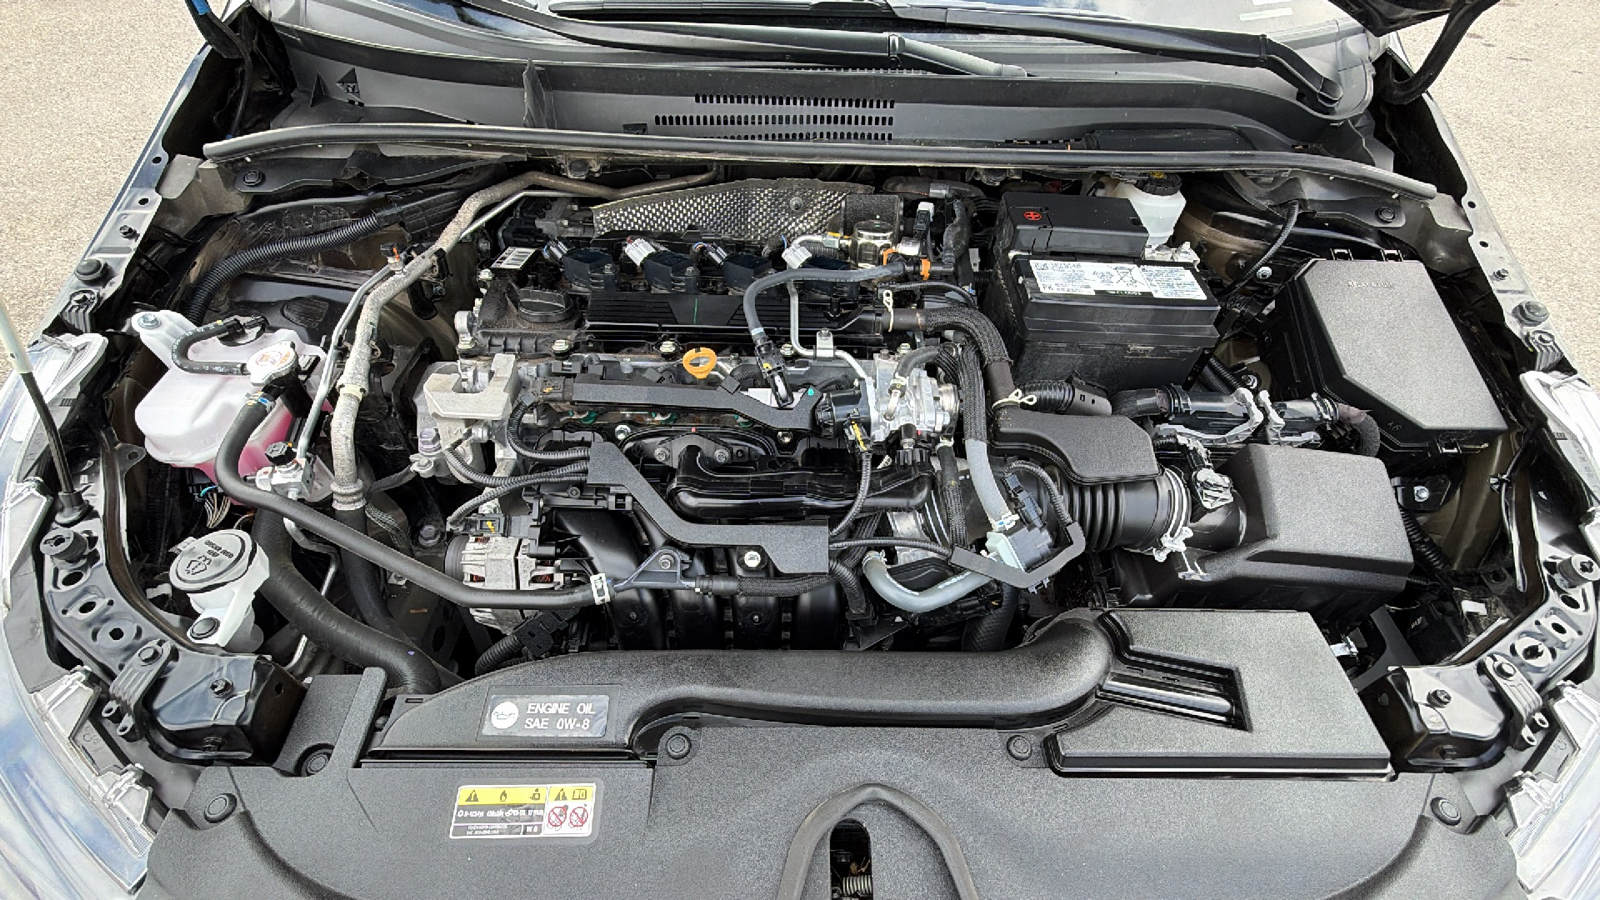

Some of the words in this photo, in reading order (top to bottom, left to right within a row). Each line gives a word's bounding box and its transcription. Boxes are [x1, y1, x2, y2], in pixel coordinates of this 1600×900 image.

[526, 702, 570, 714] ENGINE
[576, 702, 596, 714] OIL
[524, 717, 549, 729] SAE
[556, 717, 590, 730] 0W-8
